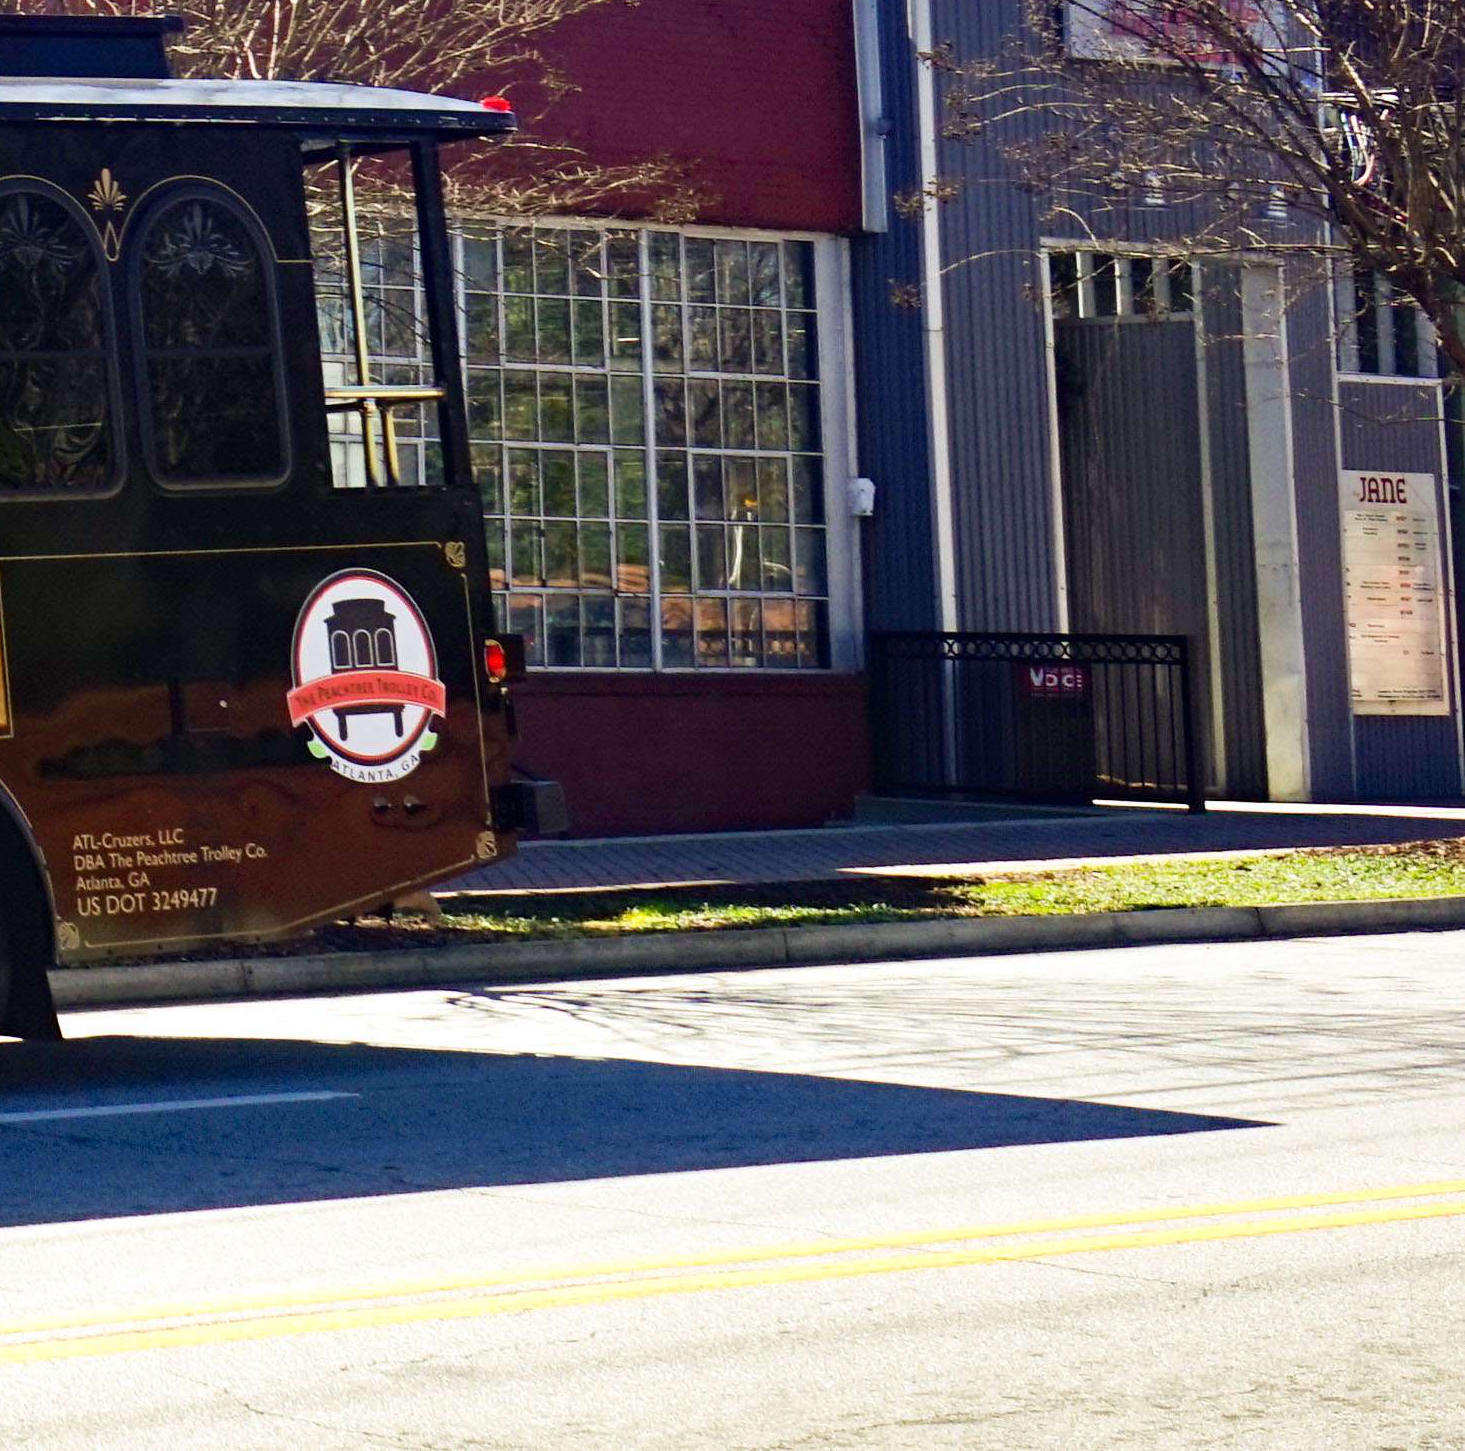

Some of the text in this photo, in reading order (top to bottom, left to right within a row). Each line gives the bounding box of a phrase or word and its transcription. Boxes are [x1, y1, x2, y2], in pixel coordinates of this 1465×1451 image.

[1359, 476, 1408, 504] JANE
[400, 754, 419, 772] GA
[158, 828, 184, 845] LLC
[73, 842, 267, 871] DBA The Peachtree Trolley Co.
[128, 871, 151, 888] GA
[77, 887, 219, 917] US DOT 3249477
